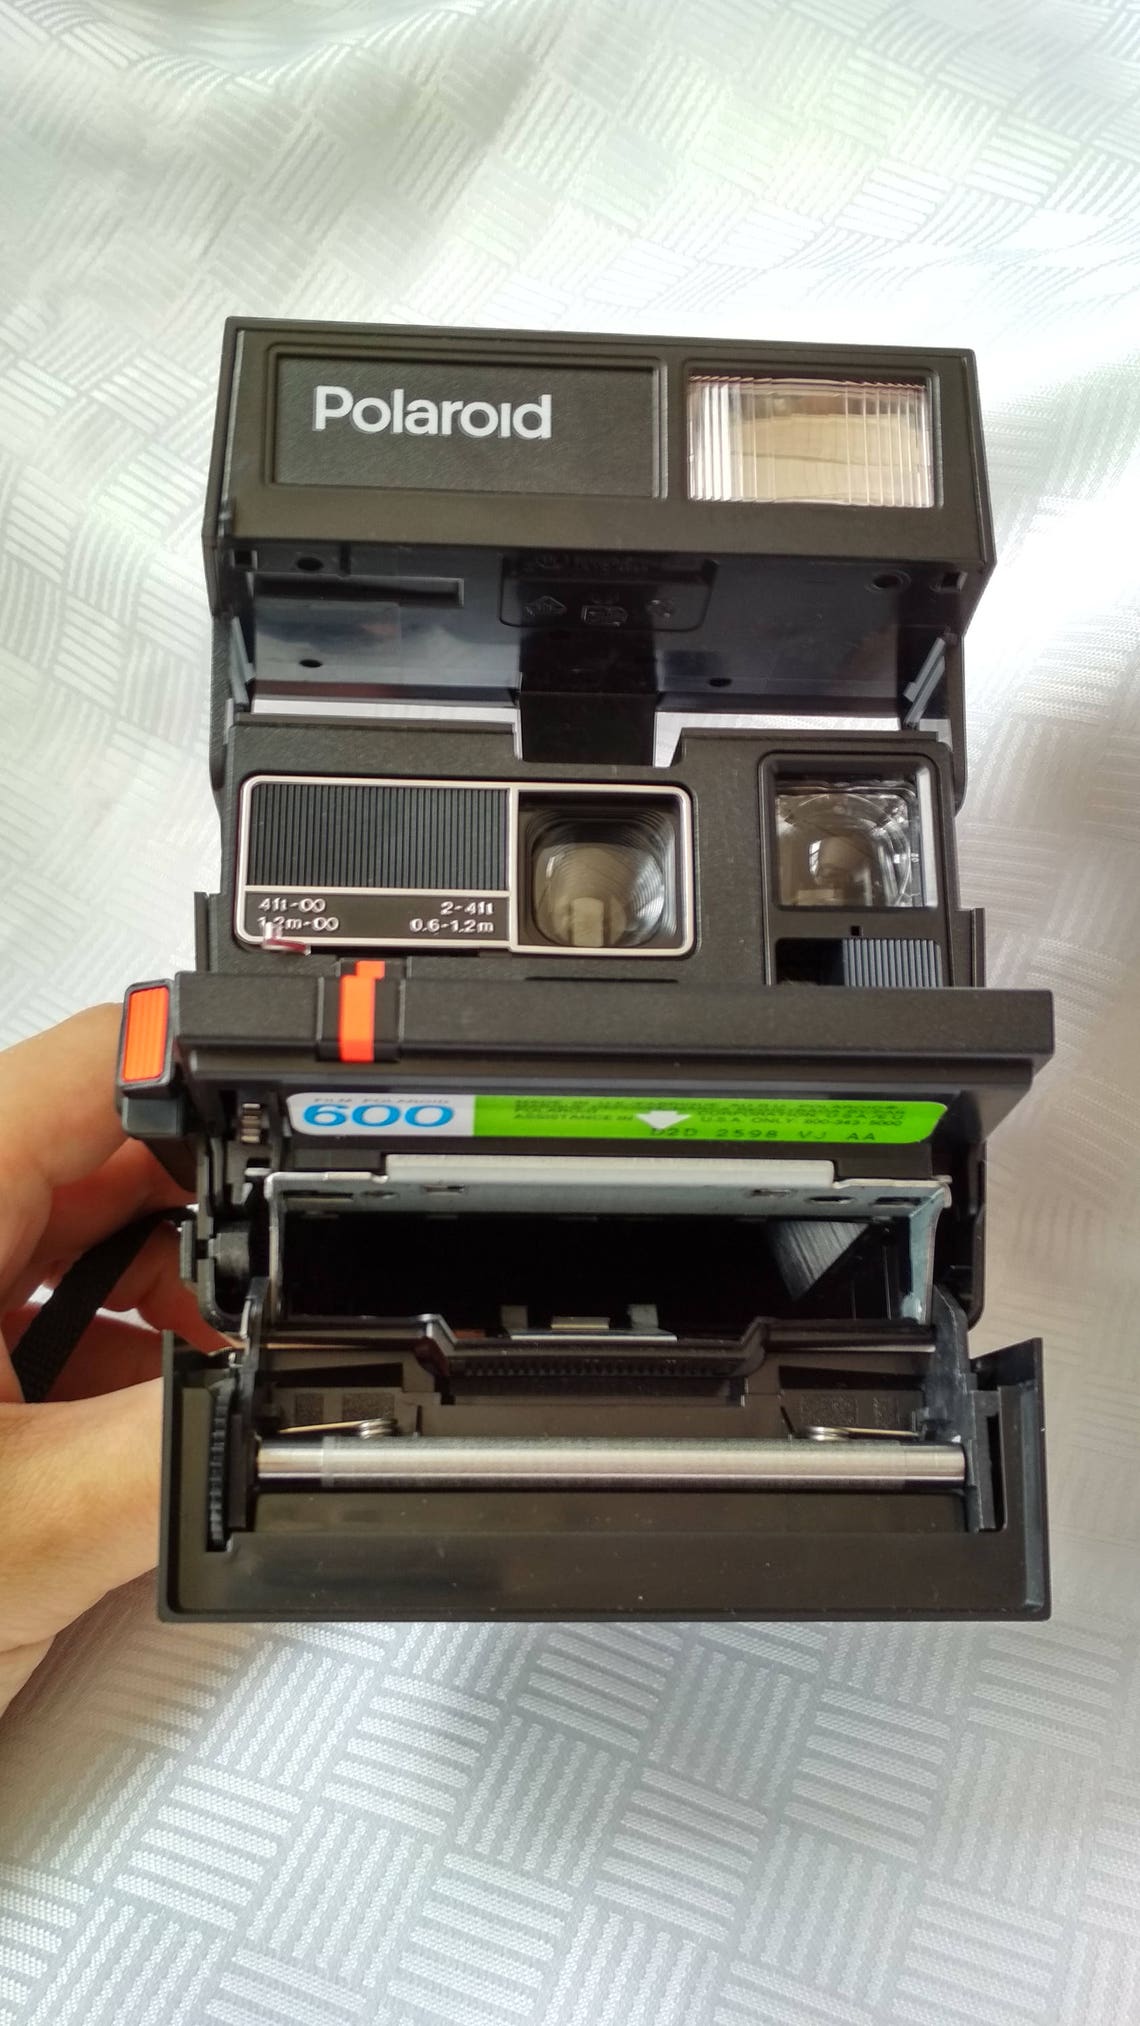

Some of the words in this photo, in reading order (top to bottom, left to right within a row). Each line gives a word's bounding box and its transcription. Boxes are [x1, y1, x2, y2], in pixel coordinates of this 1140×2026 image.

[313, 385, 552, 439] Polaroid
[409, 918, 495, 933] 0.6-1.2m
[303, 1104, 454, 1128] 600
